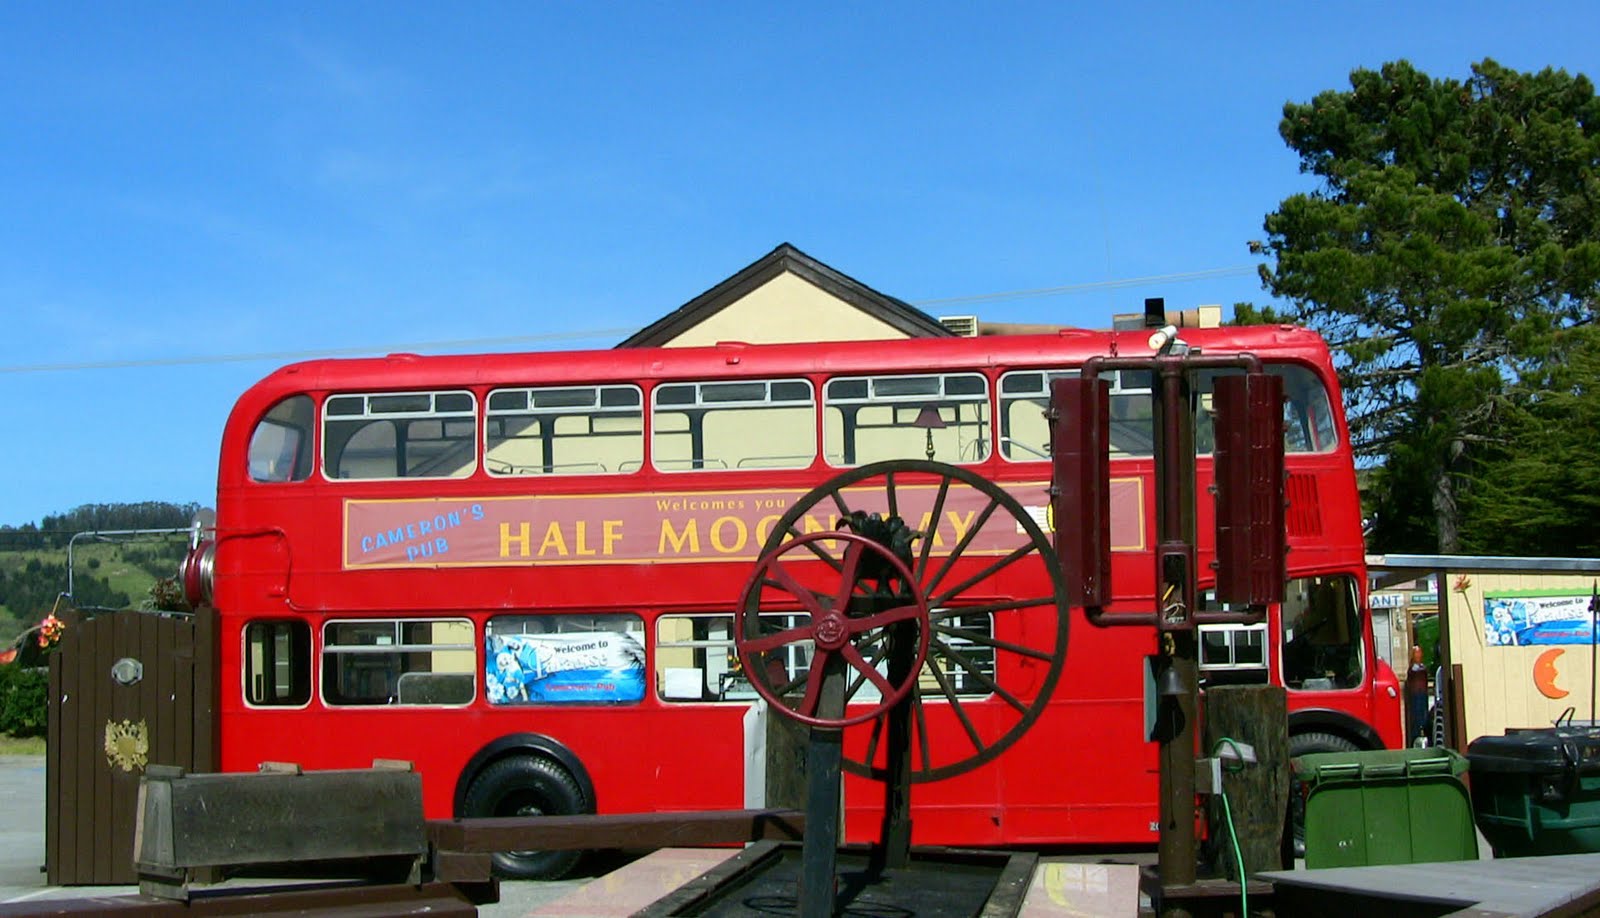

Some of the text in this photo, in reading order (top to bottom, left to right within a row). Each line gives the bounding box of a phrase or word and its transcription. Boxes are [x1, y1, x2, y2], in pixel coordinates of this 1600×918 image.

[656, 498, 786, 512] Welcomes you
[361, 504, 486, 553] CAMERON'S
[499, 520, 624, 557] HALF
[880, 510, 976, 548] AY
[406, 537, 449, 561] PUB
[1371, 595, 1401, 607] ANT
[598, 640, 609, 649] to
